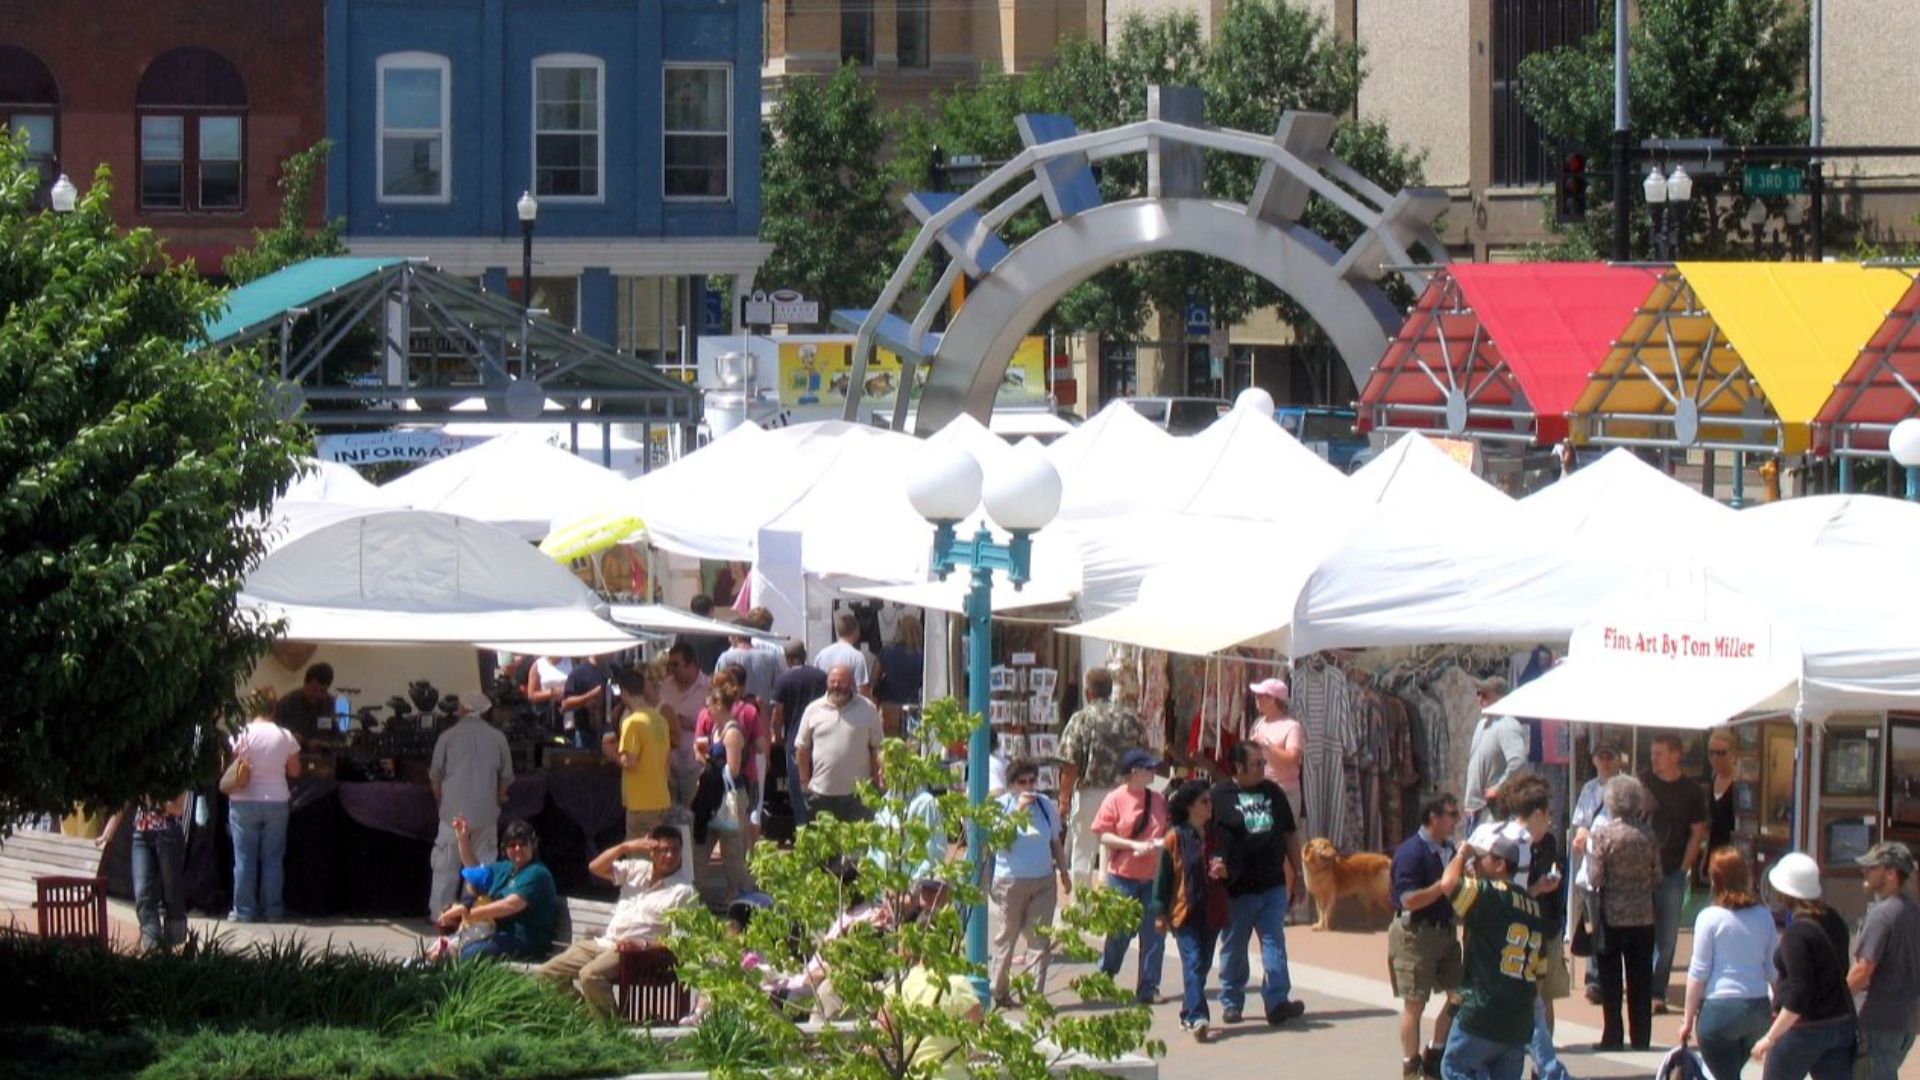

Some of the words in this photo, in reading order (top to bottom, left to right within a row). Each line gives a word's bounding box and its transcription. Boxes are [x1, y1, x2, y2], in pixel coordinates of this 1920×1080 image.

[1744, 174, 1753, 188] N
[1759, 173, 1782, 189] 3RD
[1788, 173, 1802, 190] ST
[334, 446, 462, 463] INFORMAT
[1603, 626, 1632, 650] Fine
[1635, 631, 1658, 653] Art
[1662, 633, 1678, 659] By
[1681, 634, 1711, 657] Tom
[1714, 635, 1755, 658] Miller
